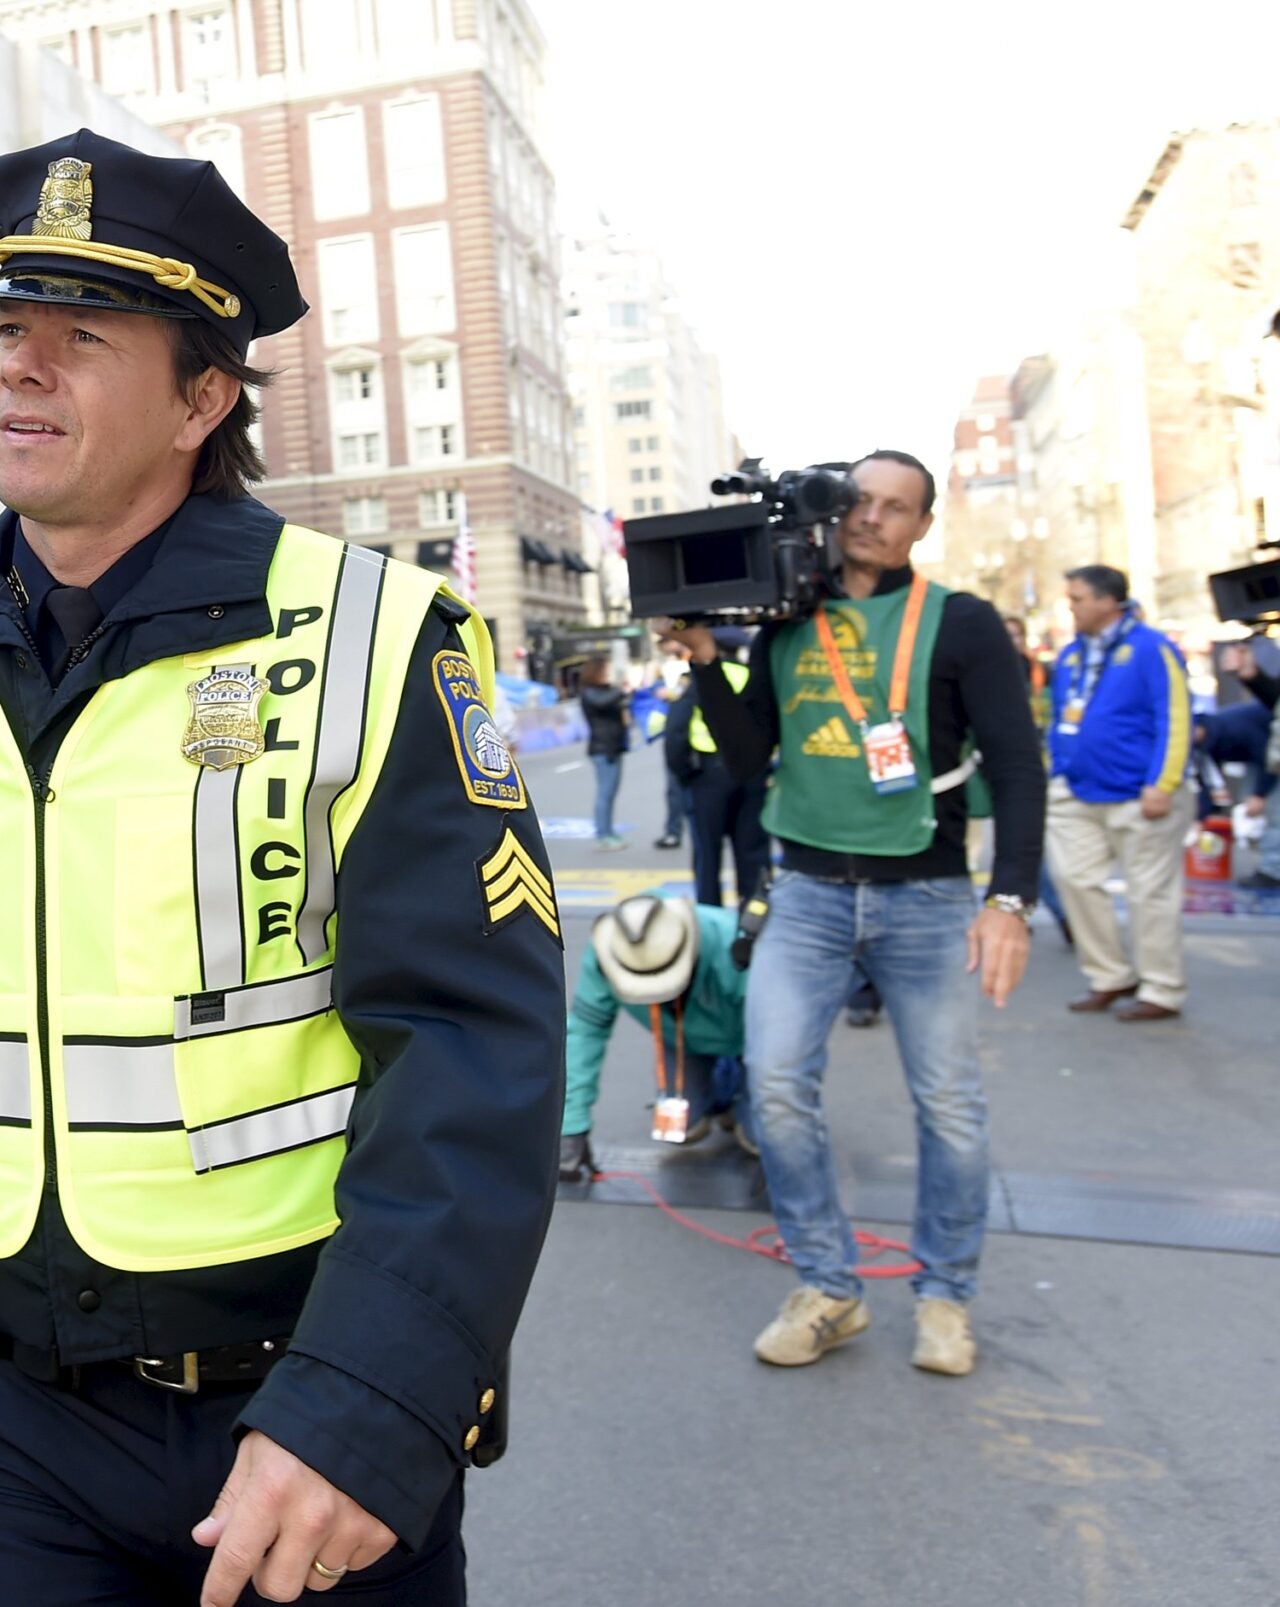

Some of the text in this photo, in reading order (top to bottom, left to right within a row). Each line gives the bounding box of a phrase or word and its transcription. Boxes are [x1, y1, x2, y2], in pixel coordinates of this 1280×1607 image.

[441, 659, 477, 681] BOST
[199, 691, 251, 702] POLICE
[250, 606, 324, 946] POLICE
[496, 783, 519, 800] 1630
